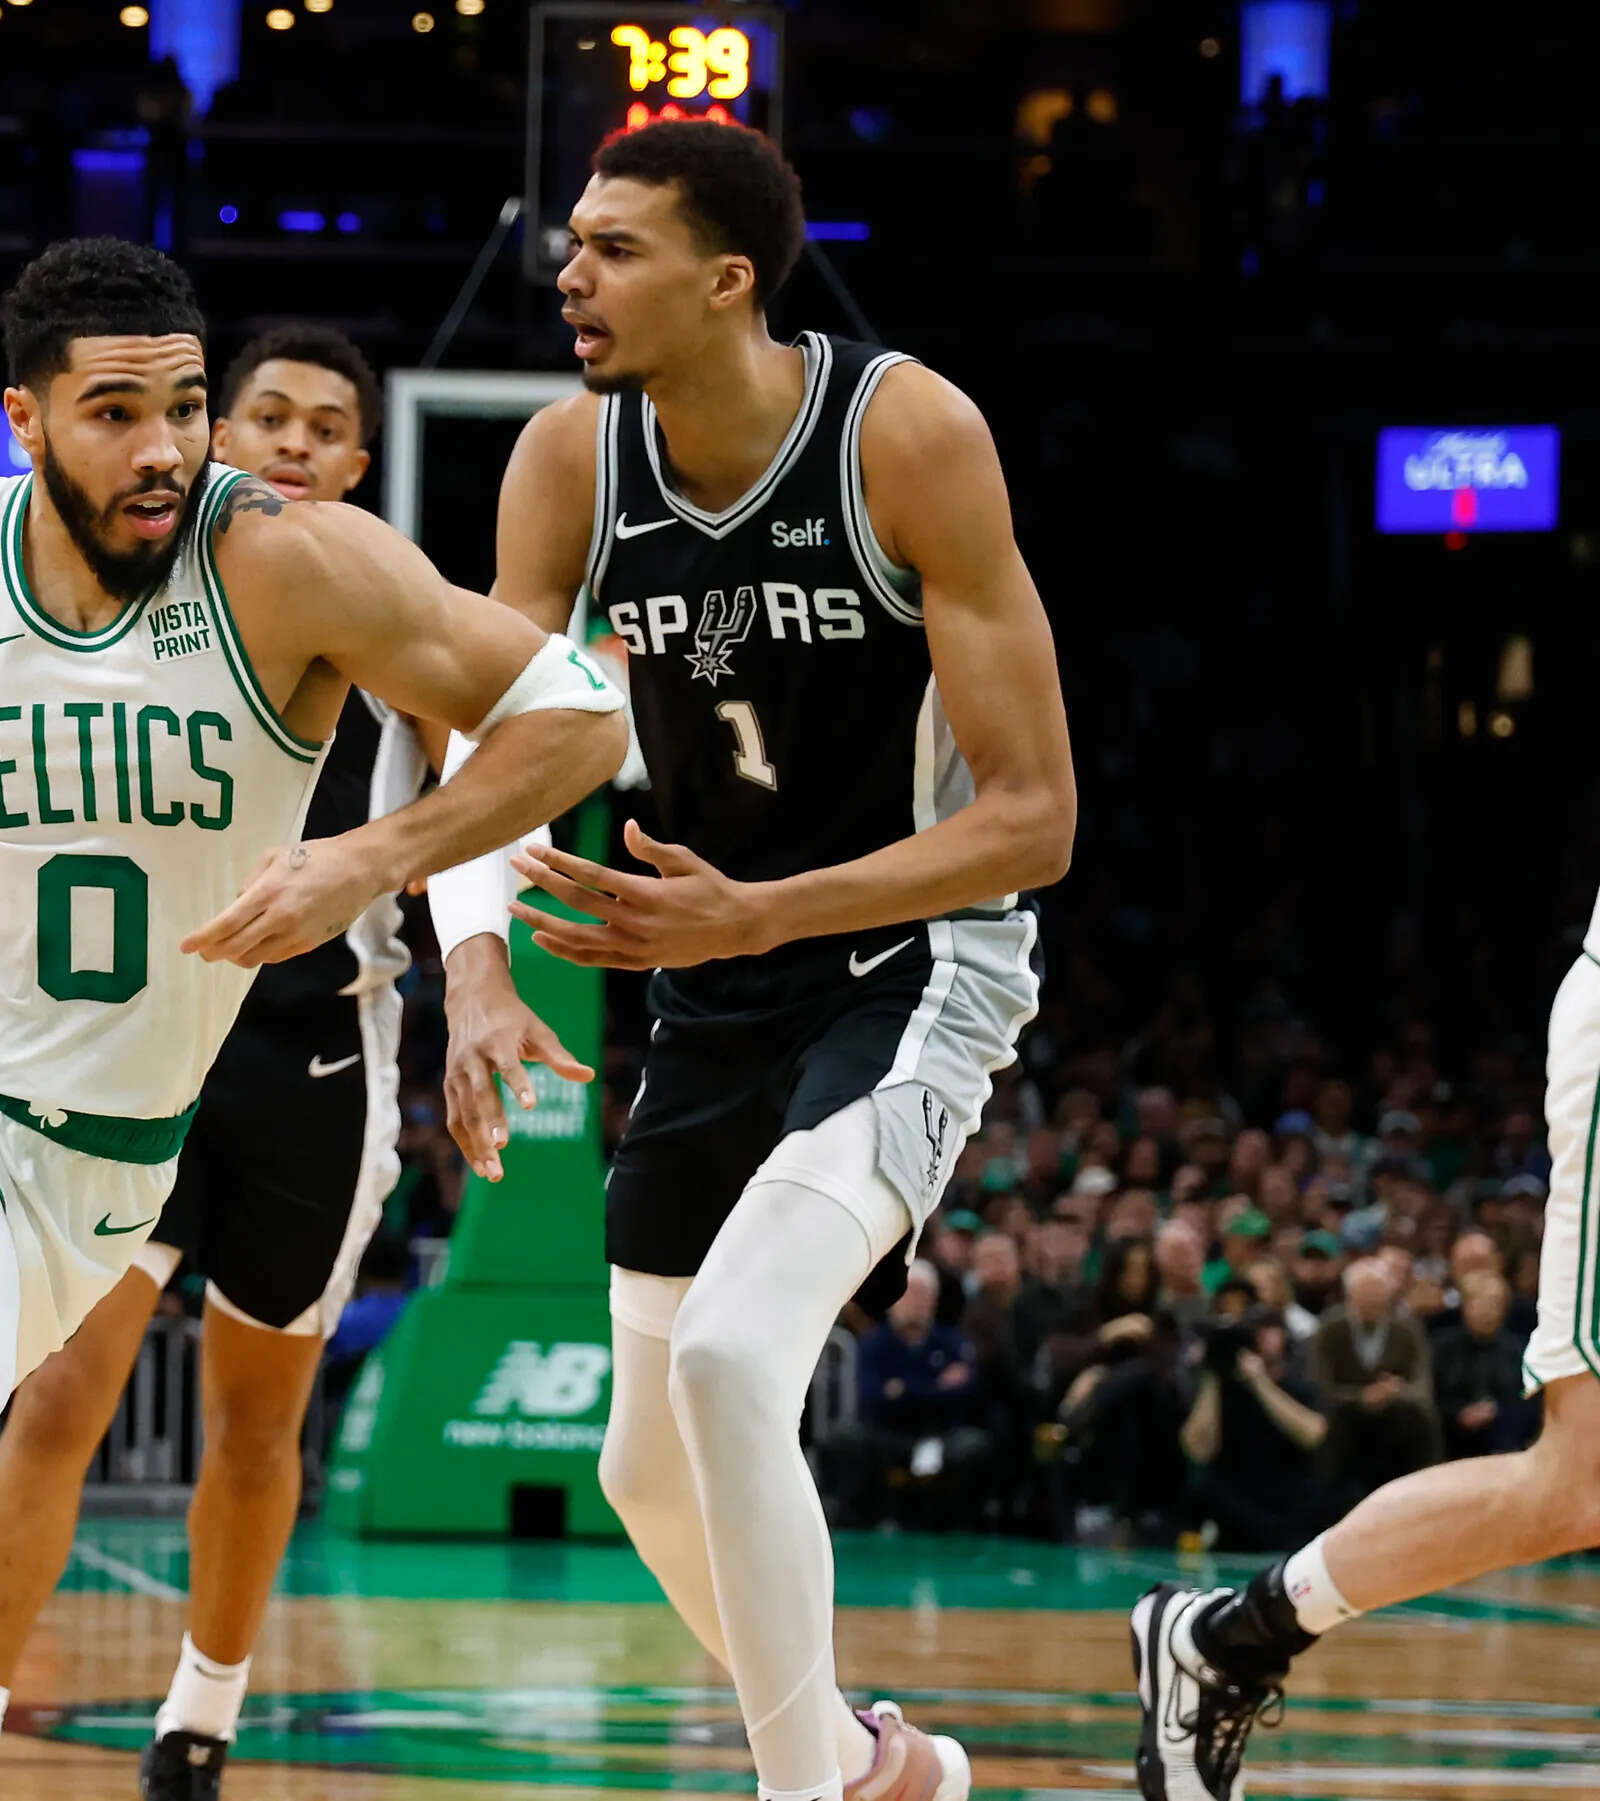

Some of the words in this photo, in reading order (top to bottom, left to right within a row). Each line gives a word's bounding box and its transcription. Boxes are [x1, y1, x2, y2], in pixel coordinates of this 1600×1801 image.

[611, 25, 749, 100] 7:39
[147, 602, 208, 638] VISTA
[153, 628, 210, 660] PRINT
[715, 701, 777, 791] 1
[37, 853, 148, 1004] 0
[473, 1340, 611, 1418] NB
[506, 1419, 605, 1452] balanc
